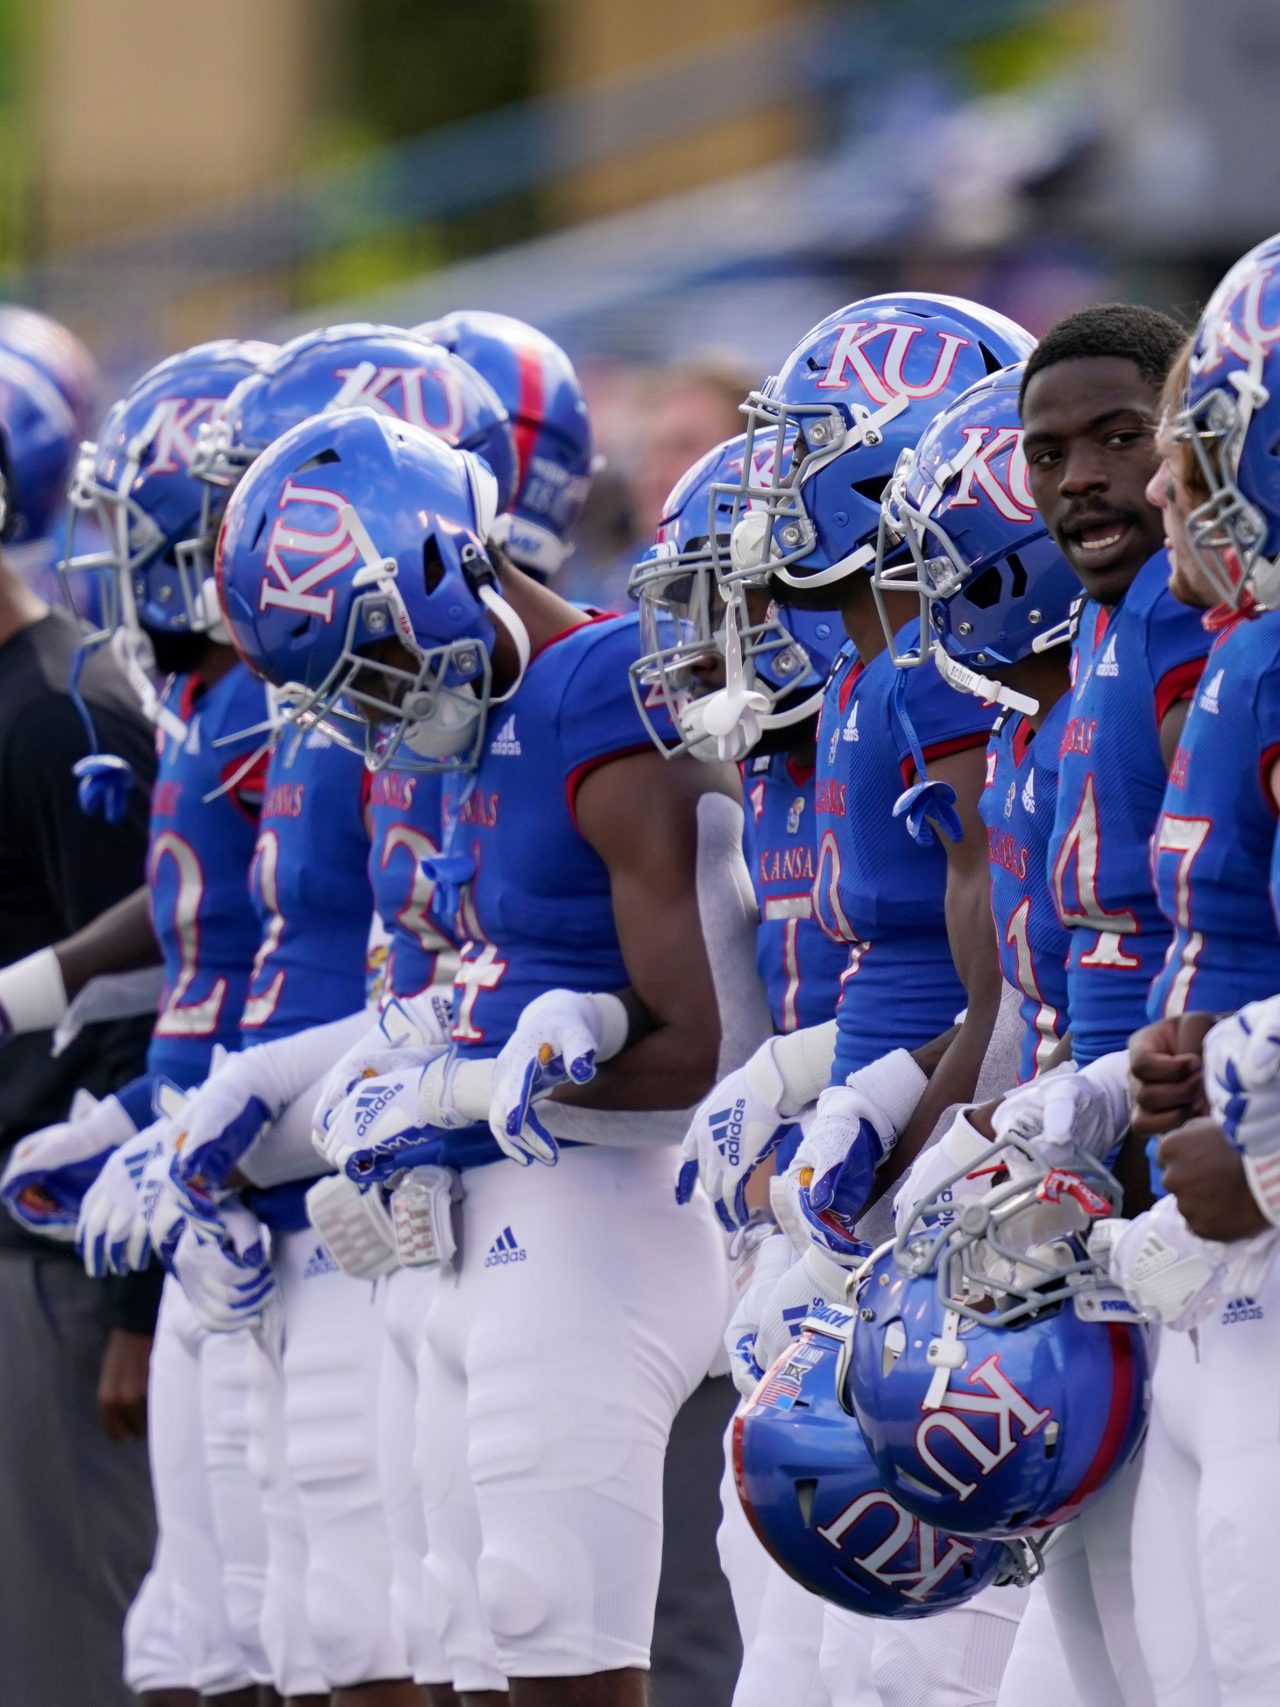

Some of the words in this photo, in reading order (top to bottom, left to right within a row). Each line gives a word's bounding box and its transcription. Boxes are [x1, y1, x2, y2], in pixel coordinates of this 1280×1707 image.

[817, 321, 970, 405] KU
[150, 397, 230, 474] K
[260, 479, 359, 624] KU
[759, 845, 816, 885] KANSA
[1053, 772, 1141, 970] 4
[357, 1083, 404, 1137] adidas
[726, 1098, 746, 1167] adidas
[484, 1249, 527, 1268] adidas
[916, 1353, 1052, 1502] KU
[816, 1488, 976, 1603] KU
